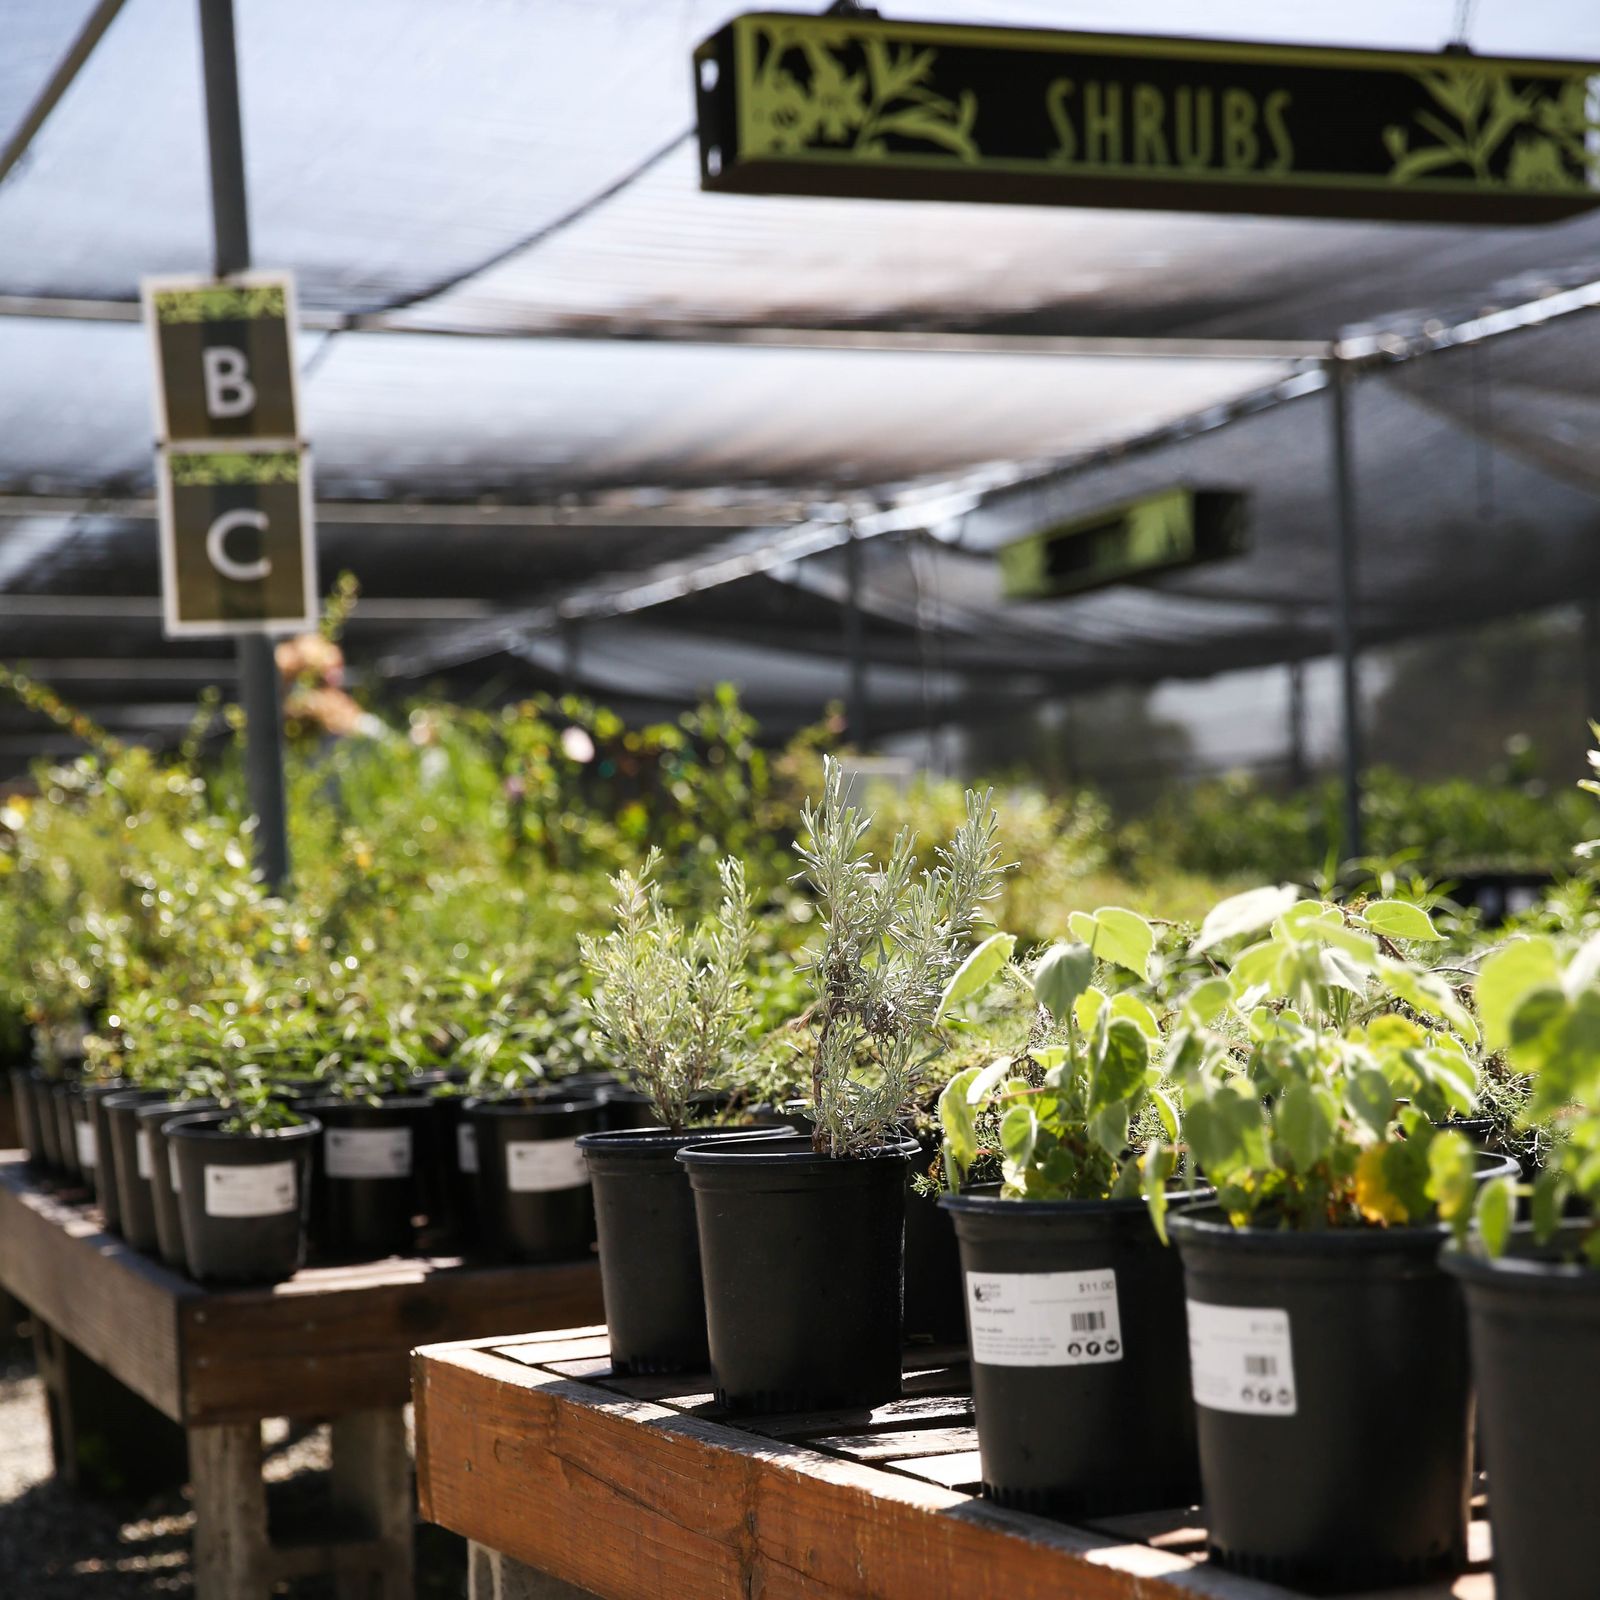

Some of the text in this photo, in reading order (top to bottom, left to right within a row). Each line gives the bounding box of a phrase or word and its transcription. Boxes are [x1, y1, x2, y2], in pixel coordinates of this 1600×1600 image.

[1046, 77, 1295, 176] SHRUBS
[202, 345, 257, 418] B
[206, 508, 272, 581] C
